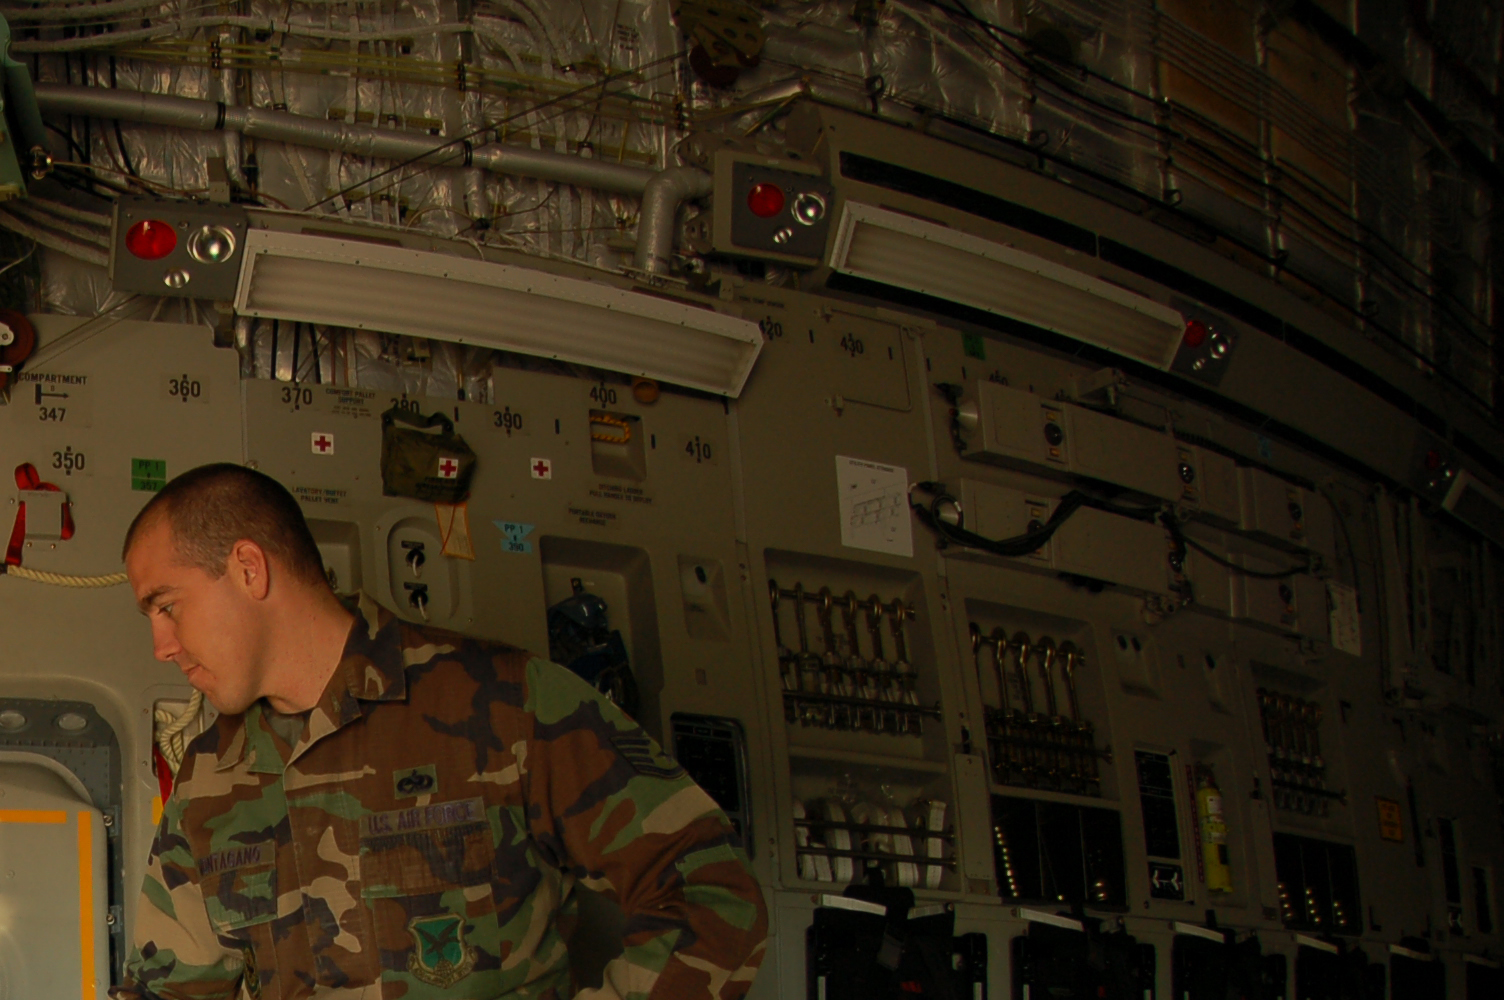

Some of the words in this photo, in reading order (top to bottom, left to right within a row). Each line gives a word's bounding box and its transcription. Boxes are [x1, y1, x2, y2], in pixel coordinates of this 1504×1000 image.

[758, 319, 783, 338] 420
[840, 336, 864, 355] 430
[17, 372, 88, 386] COMPARTMENT
[168, 378, 201, 398] 360
[281, 387, 313, 405] 370
[589, 387, 617, 405] 400
[39, 406, 66, 422] 347
[493, 410, 523, 430] 390
[685, 441, 712, 460] 410
[52, 451, 86, 470] 350
[139, 460, 151, 470] PP
[504, 523, 516, 533] PP
[397, 809, 420, 829] AIR
[424, 800, 474, 826] FORCE
